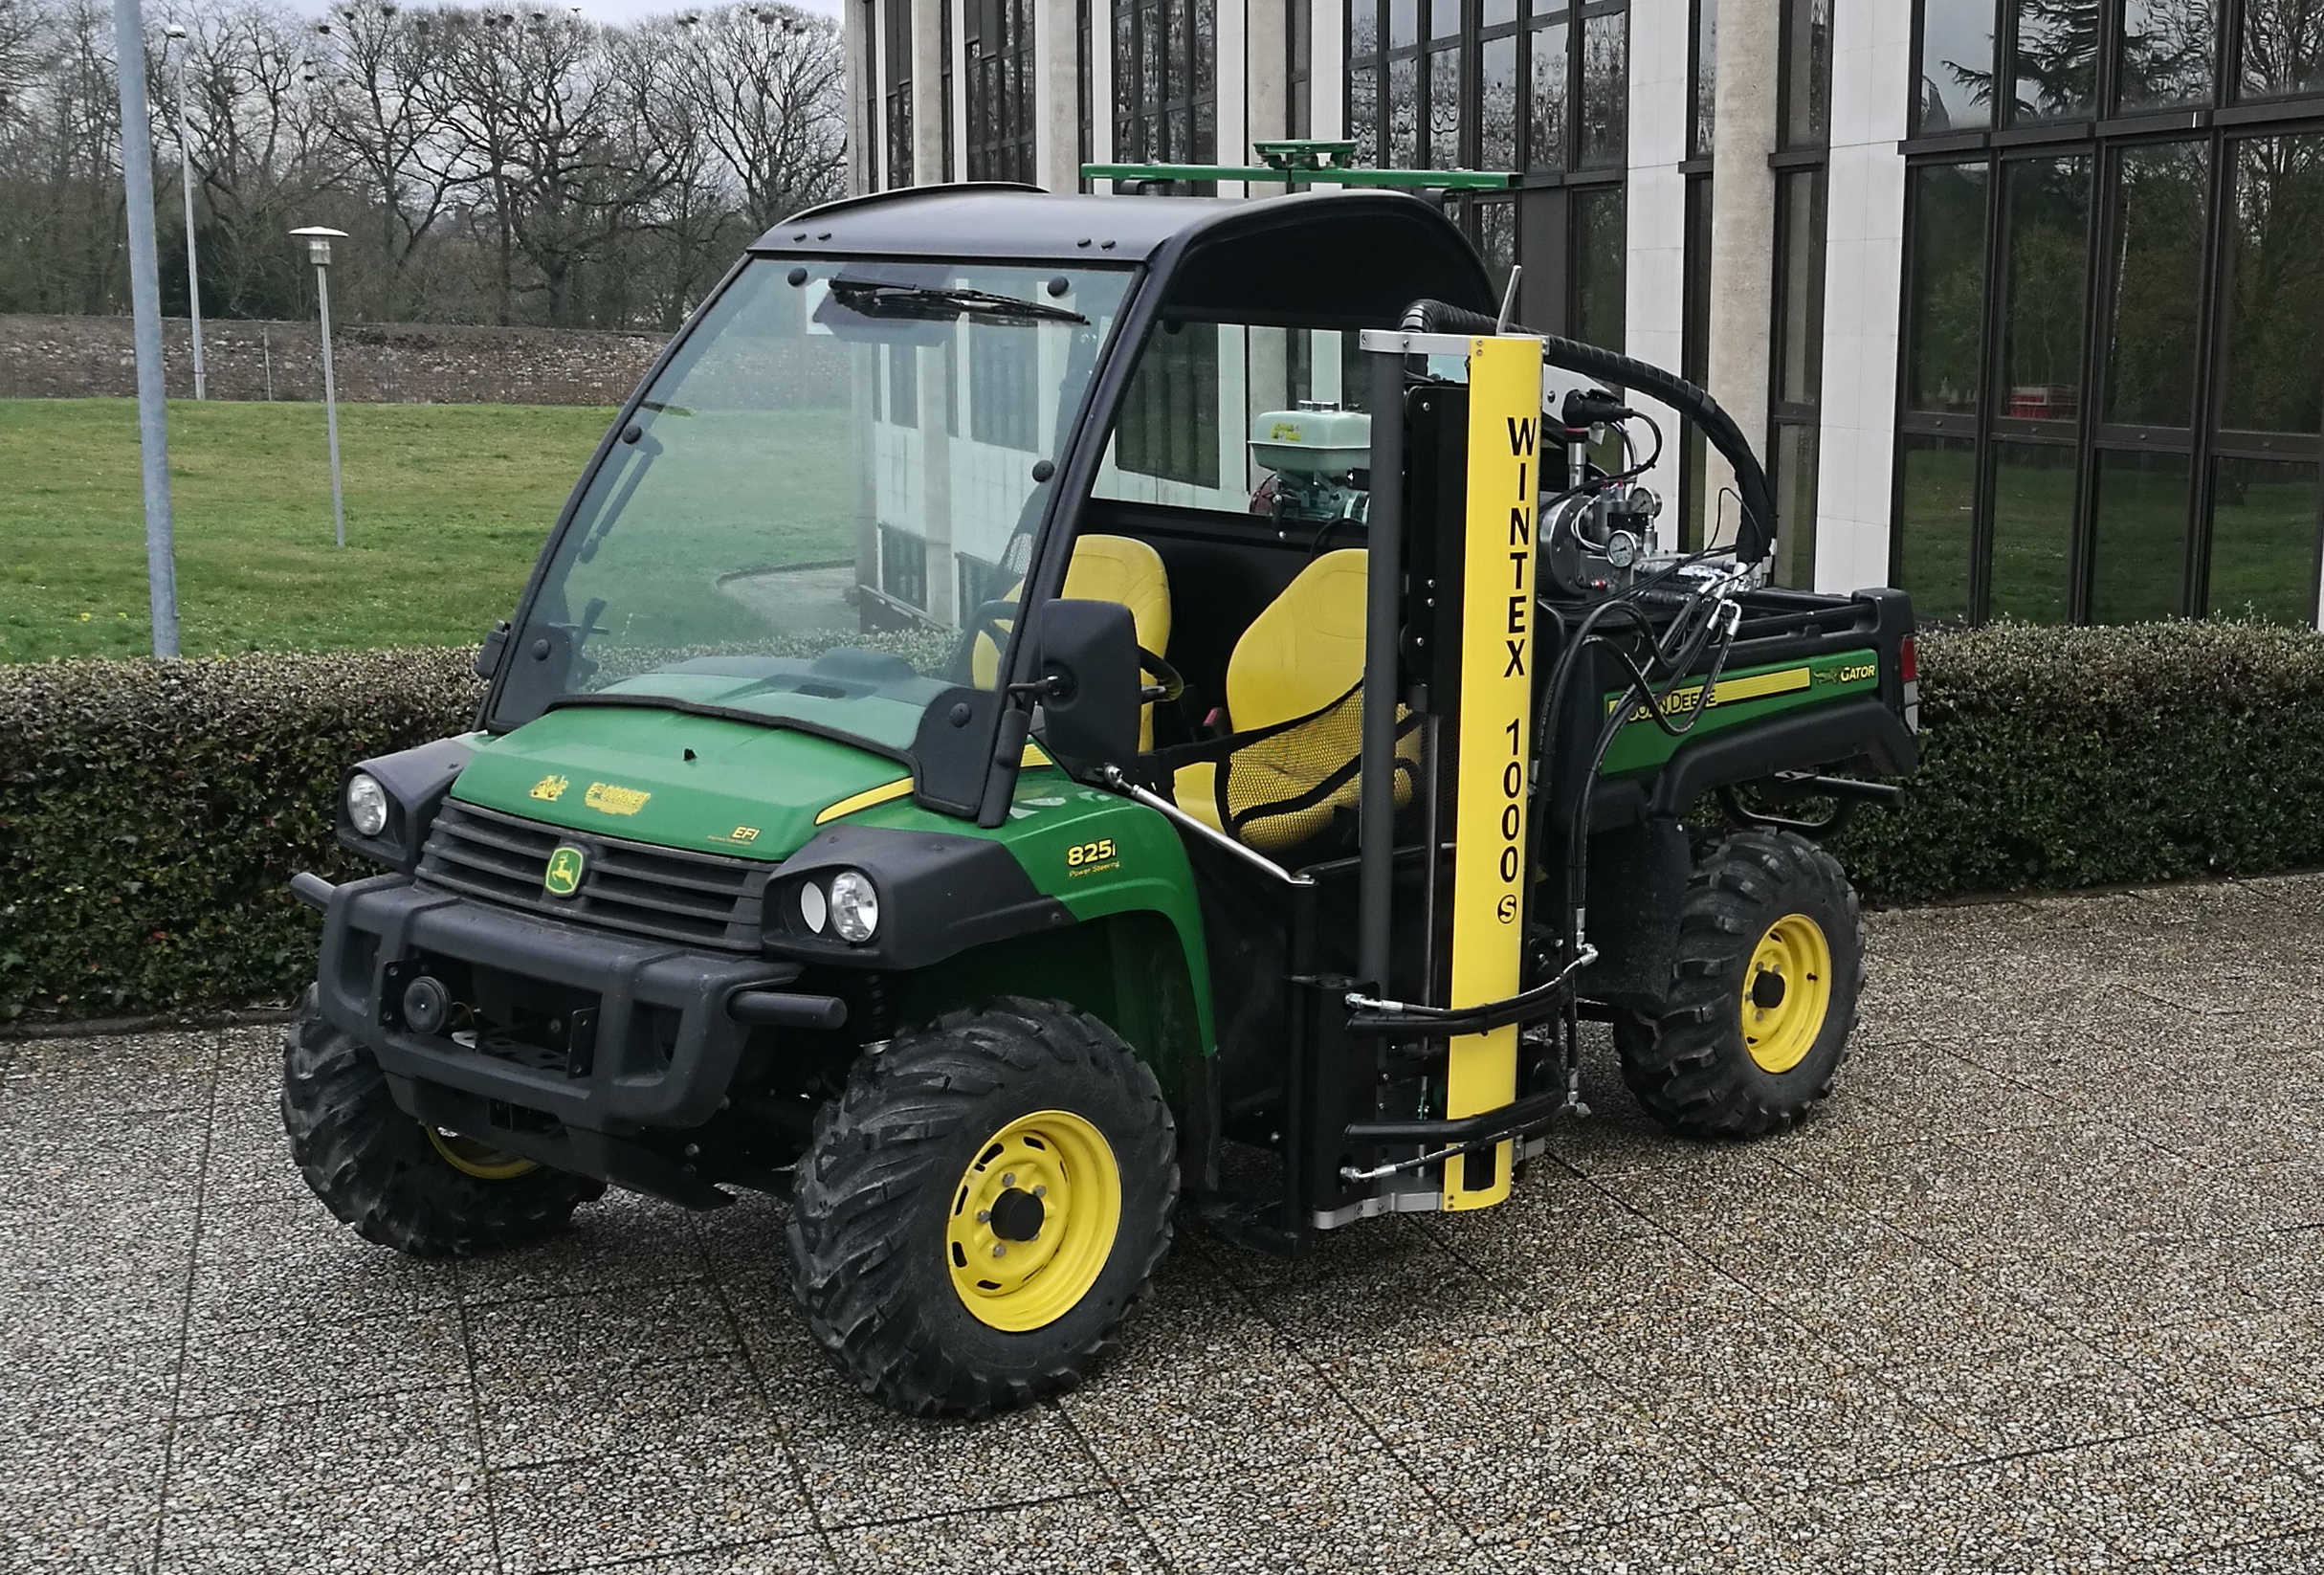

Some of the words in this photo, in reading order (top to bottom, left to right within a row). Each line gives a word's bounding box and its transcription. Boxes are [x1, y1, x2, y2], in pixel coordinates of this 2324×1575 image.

[1503, 416, 1537, 677] WINTEX
[1840, 664, 1875, 682] GATOR
[1628, 698, 1669, 721] ON
[1671, 689, 1716, 712] DEEE
[1499, 718, 1521, 883] 1000
[731, 825, 761, 841] EFI
[1067, 837, 1116, 867] 825i
